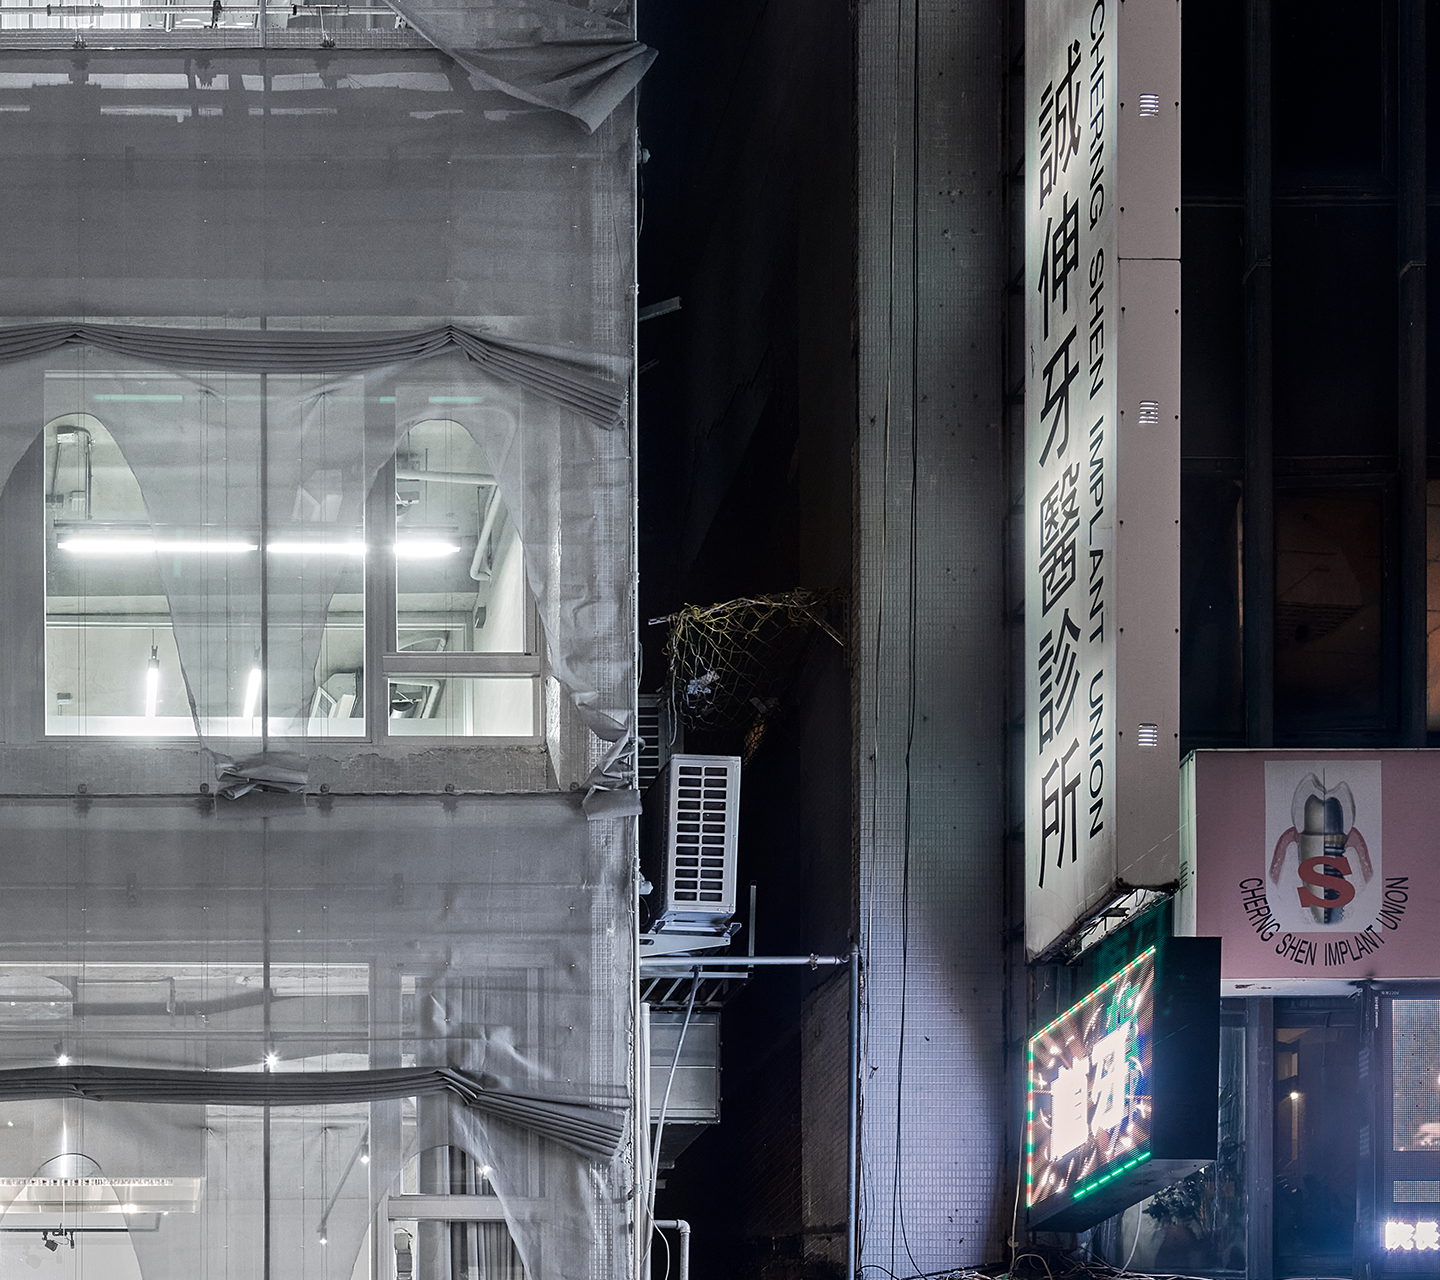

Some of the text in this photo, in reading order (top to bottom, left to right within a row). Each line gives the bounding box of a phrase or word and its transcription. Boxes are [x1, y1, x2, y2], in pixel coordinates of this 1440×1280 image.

[1087, 254, 1106, 402] SHEN
[1038, 40, 1082, 889] 誠伸牙醫診所
[1087, 420, 1106, 644] IMPLANT
[1087, 674, 1105, 839] UNION
[1239, 876, 1410, 967] CHERNG SHEN IMPLANT UNION
